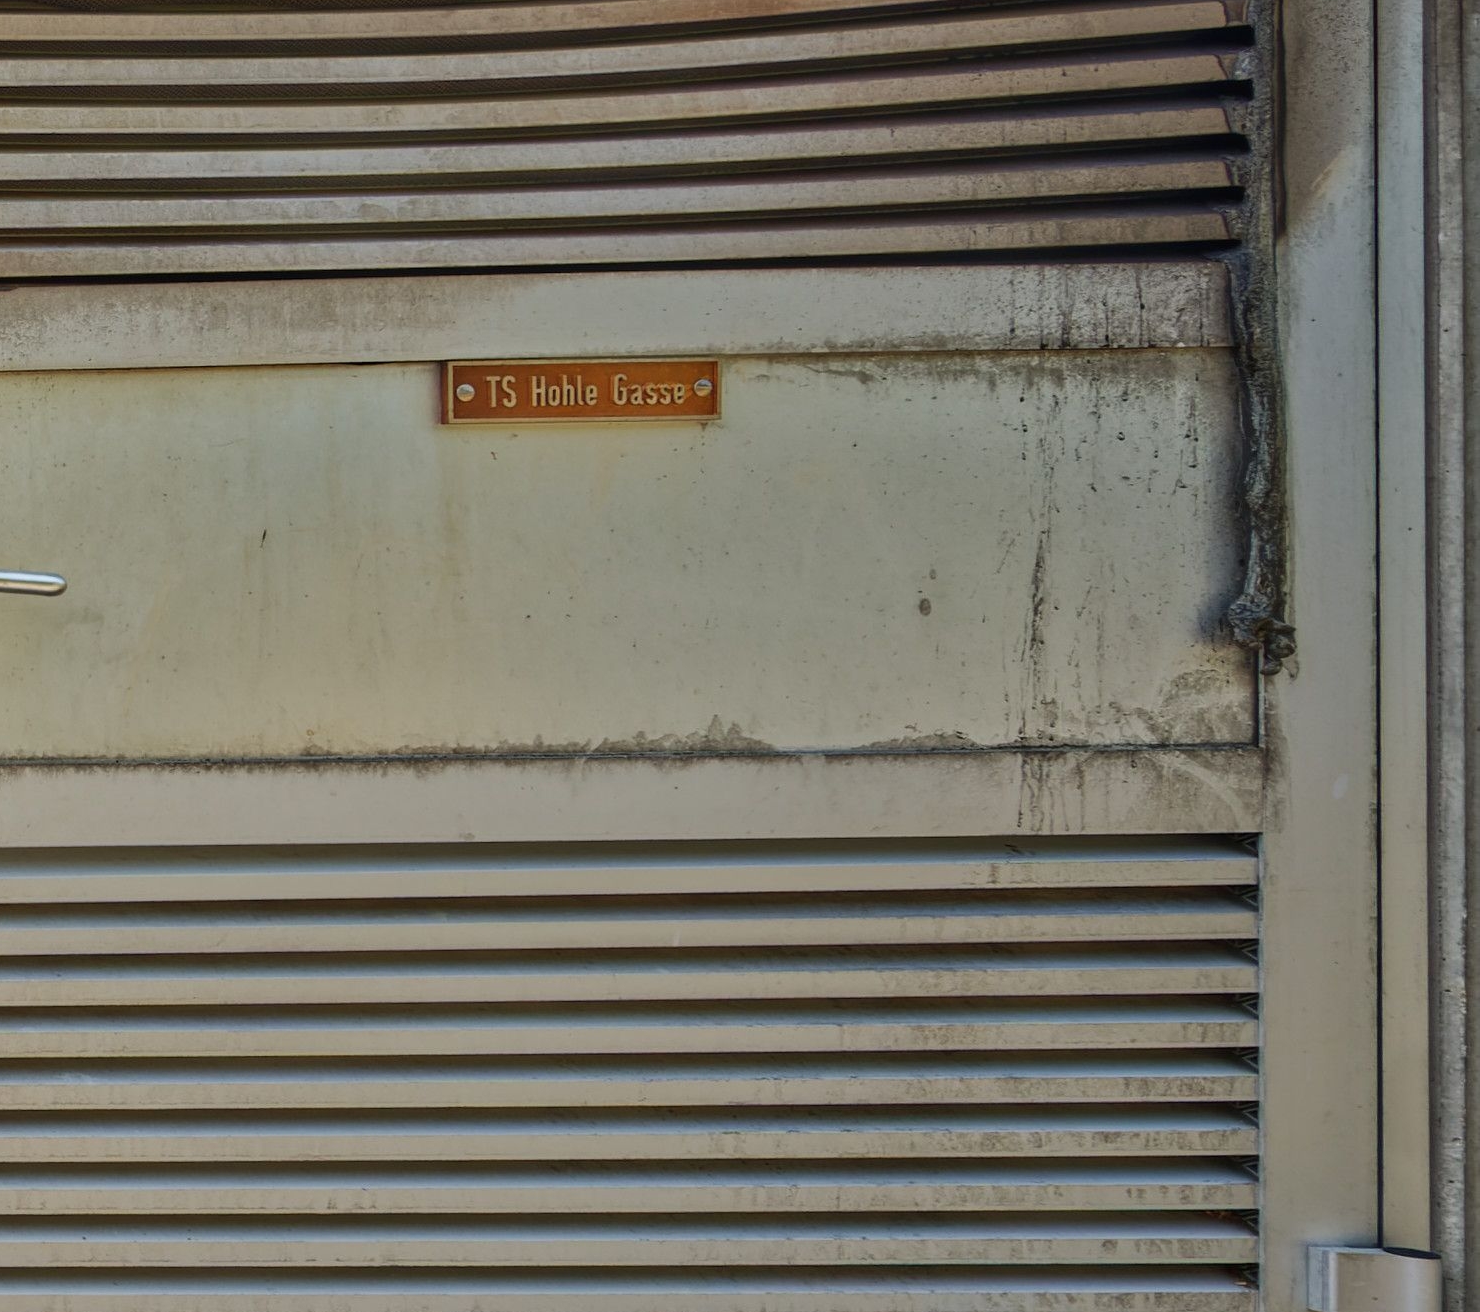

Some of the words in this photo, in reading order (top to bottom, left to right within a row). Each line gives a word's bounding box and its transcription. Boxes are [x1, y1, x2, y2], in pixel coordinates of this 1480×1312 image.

[485, 375, 517, 408] TS
[530, 374, 598, 407] Hohle
[612, 373, 686, 406] Gasse
